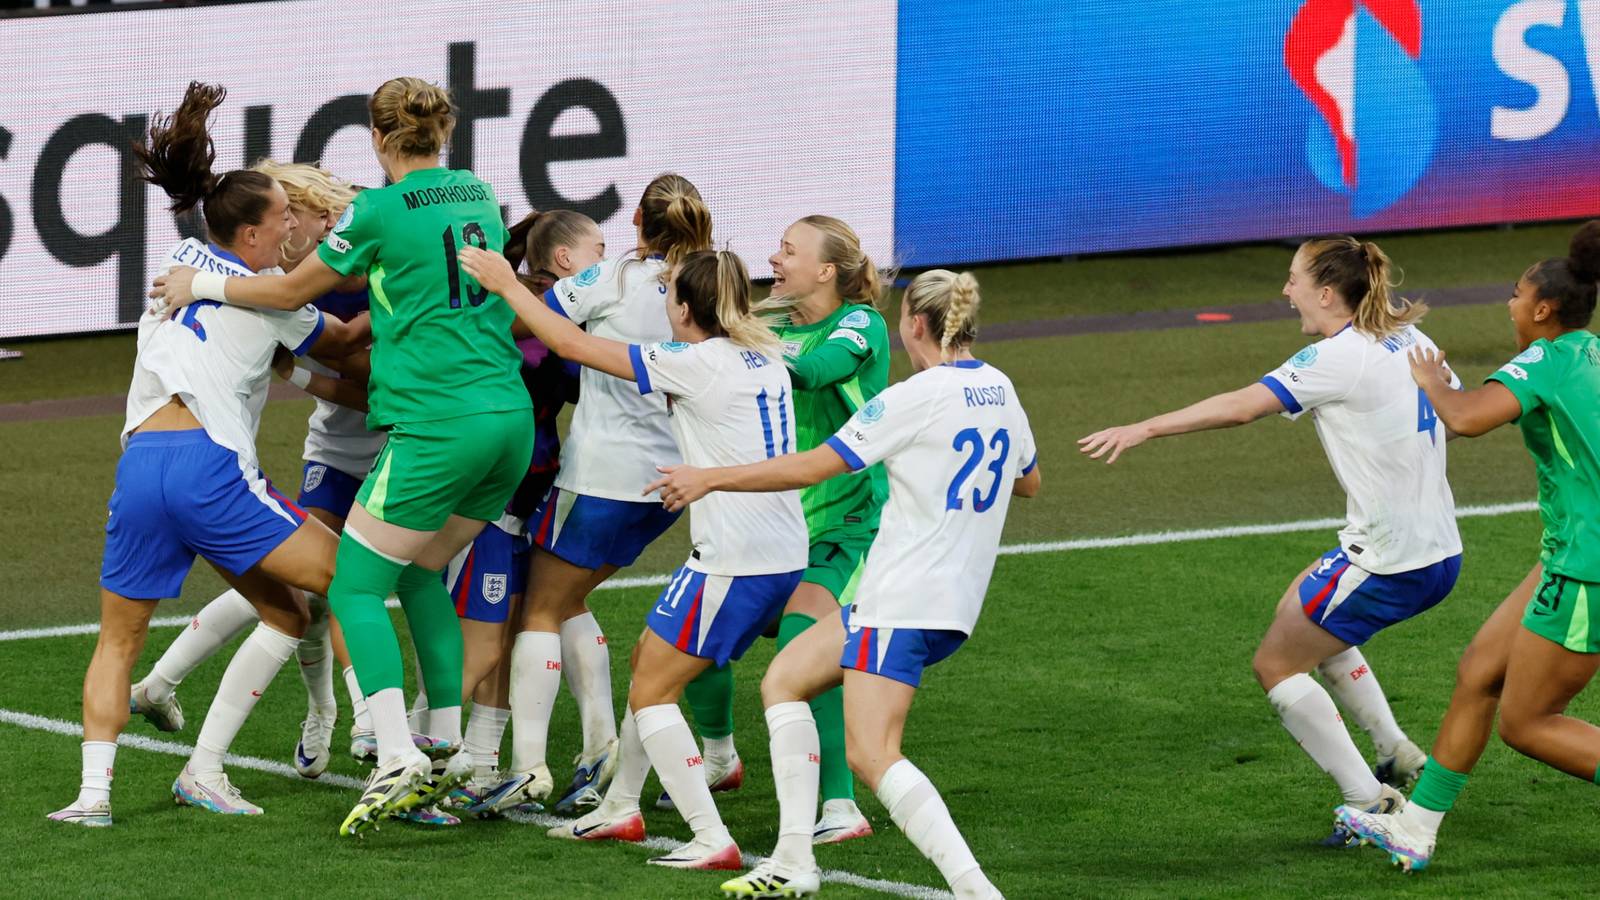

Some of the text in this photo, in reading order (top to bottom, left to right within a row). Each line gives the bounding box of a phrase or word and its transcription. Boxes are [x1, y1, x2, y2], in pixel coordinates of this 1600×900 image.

[402, 184, 490, 211] MOORHOUSE
[172, 241, 193, 263] LE
[963, 385, 1006, 408] RUSSO
[1417, 386, 1438, 449] 4
[756, 386, 789, 459] 11
[945, 427, 1010, 514] 23
[664, 566, 695, 609] 11
